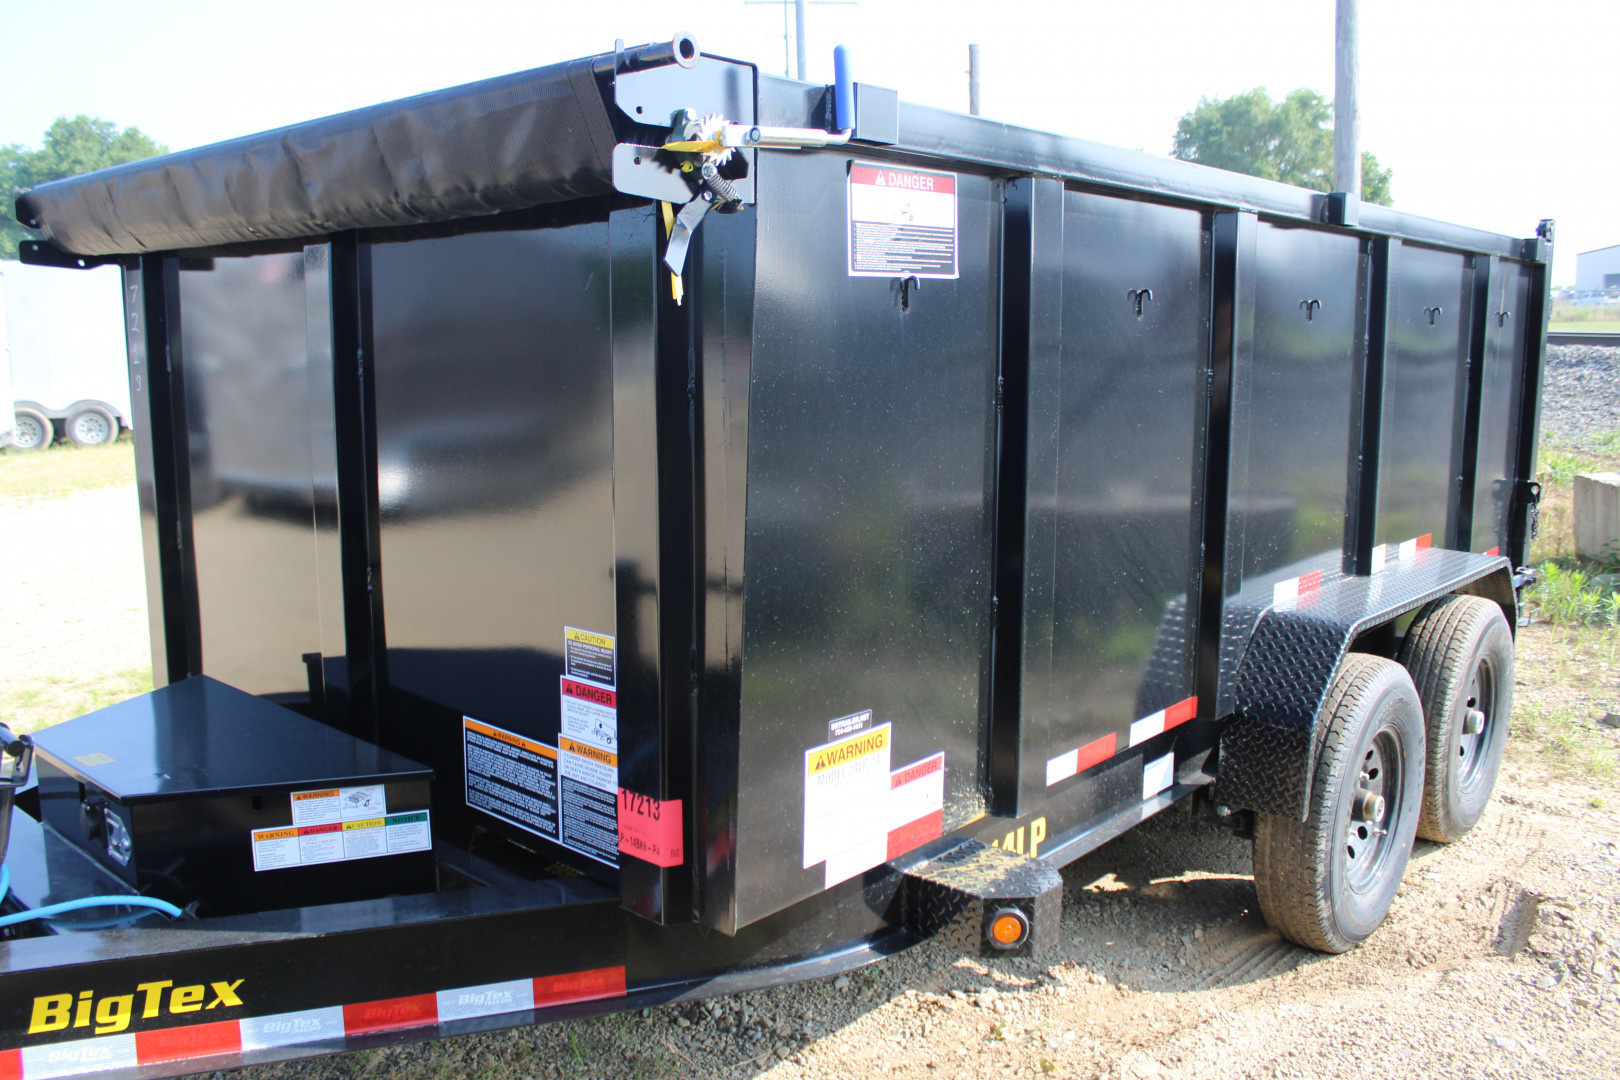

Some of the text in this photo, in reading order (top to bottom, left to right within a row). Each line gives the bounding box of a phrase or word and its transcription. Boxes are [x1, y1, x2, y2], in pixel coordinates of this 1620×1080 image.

[888, 172, 934, 191] DANGER
[580, 633, 606, 646] CAUTION
[575, 685, 613, 705] DANGER
[497, 732, 521, 746] WARNING
[576, 744, 612, 764] WARNING
[826, 734, 883, 766] WARNING
[904, 760, 937, 783] DANGER
[302, 790, 335, 800] WARNING
[621, 789, 660, 821] 17213
[351, 820, 382, 829] CAUTION
[392, 815, 420, 824] NOTICE
[257, 830, 295, 841] WARNING
[310, 826, 338, 834] DANGER
[990, 815, 1047, 859] 4LP
[458, 990, 513, 1006] BigTex
[28, 979, 245, 1035] BigTex
[263, 1017, 322, 1034] BigTex
[48, 1046, 112, 1063] BigTex
